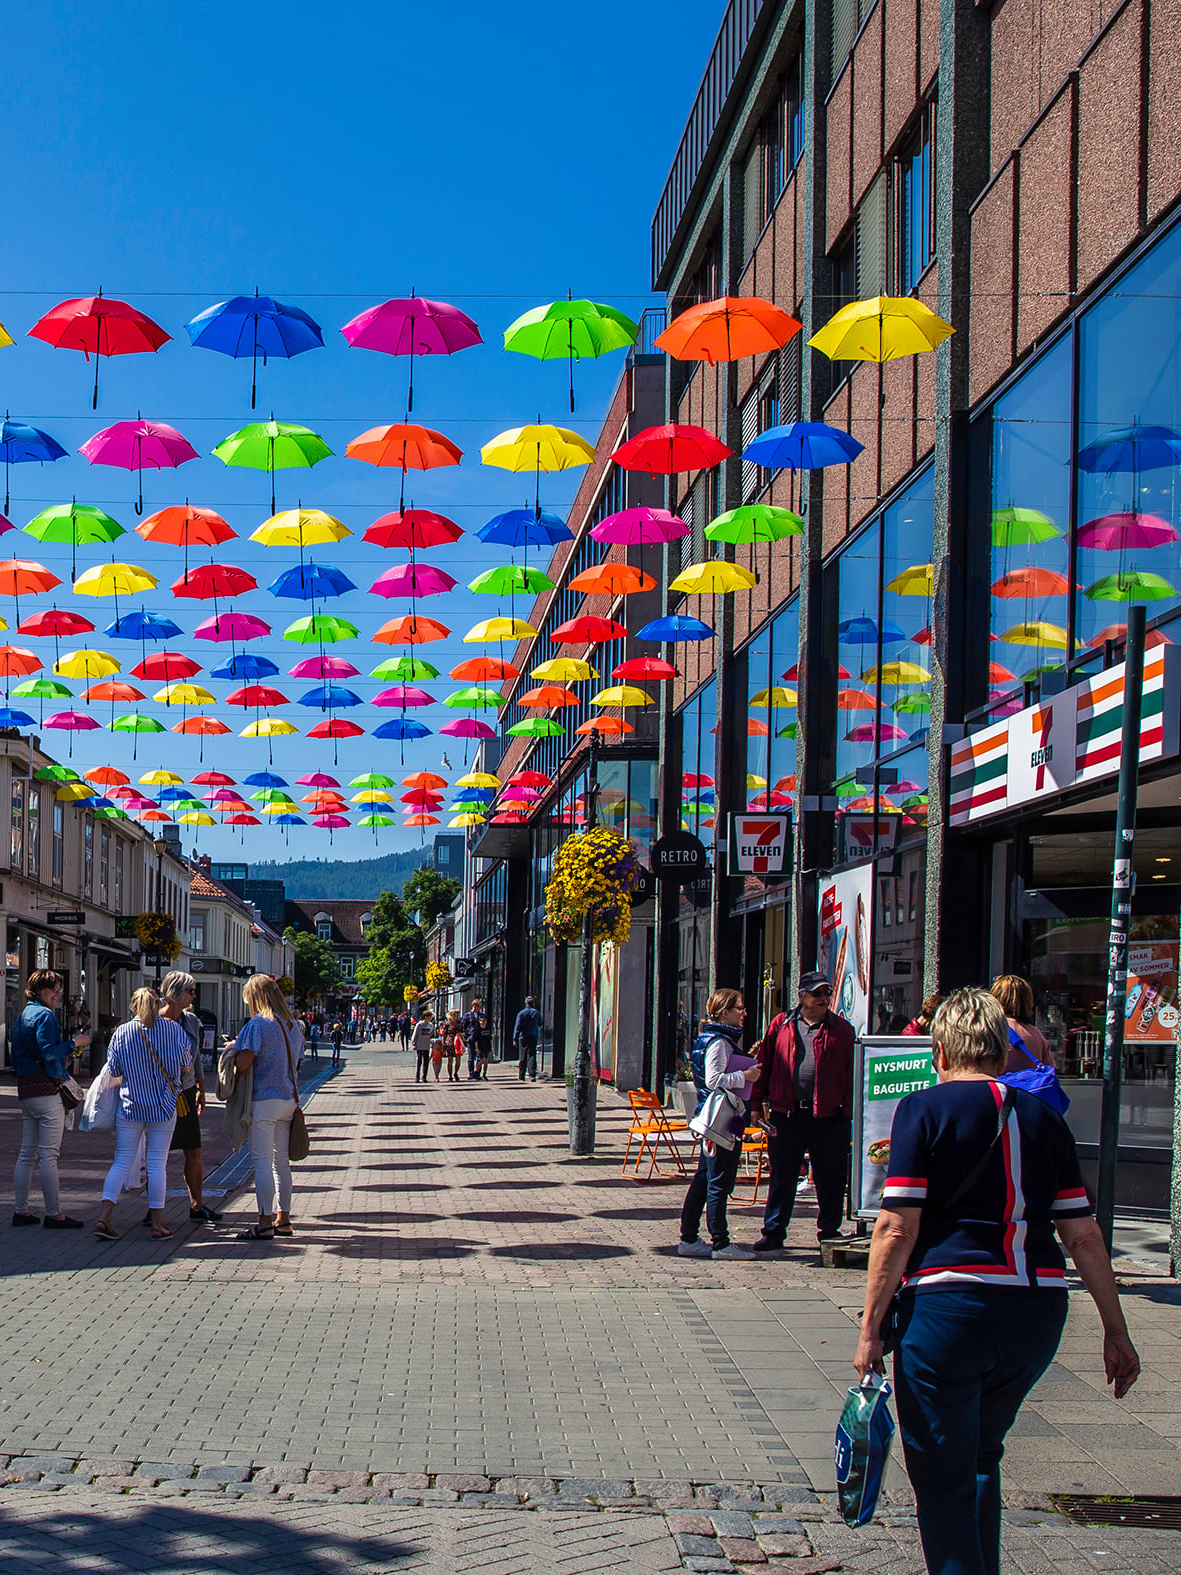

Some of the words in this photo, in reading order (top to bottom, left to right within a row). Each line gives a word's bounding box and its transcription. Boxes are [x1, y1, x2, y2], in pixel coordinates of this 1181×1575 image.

[1031, 705, 1053, 791] 7
[742, 820, 781, 873] 7
[660, 850, 698, 863] RETRO
[1129, 952, 1149, 962] SMAK
[1139, 961, 1170, 974] SOMMER
[874, 1058, 928, 1074] NYSMURT
[873, 1080, 931, 1096] BAGUETTE
